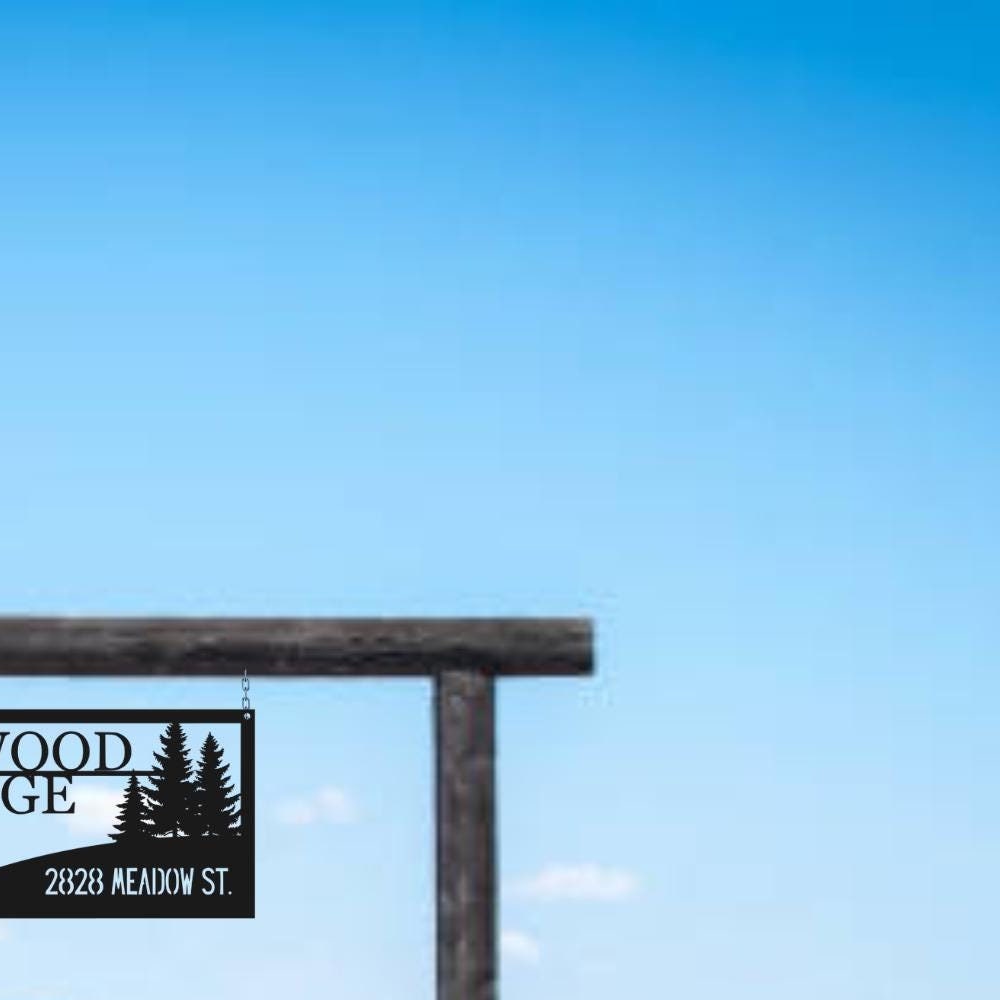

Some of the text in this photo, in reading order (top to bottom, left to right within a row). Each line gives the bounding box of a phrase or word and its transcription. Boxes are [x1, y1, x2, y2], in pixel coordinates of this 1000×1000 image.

[45, 867, 233, 896] 2828 MEADOW ST.
